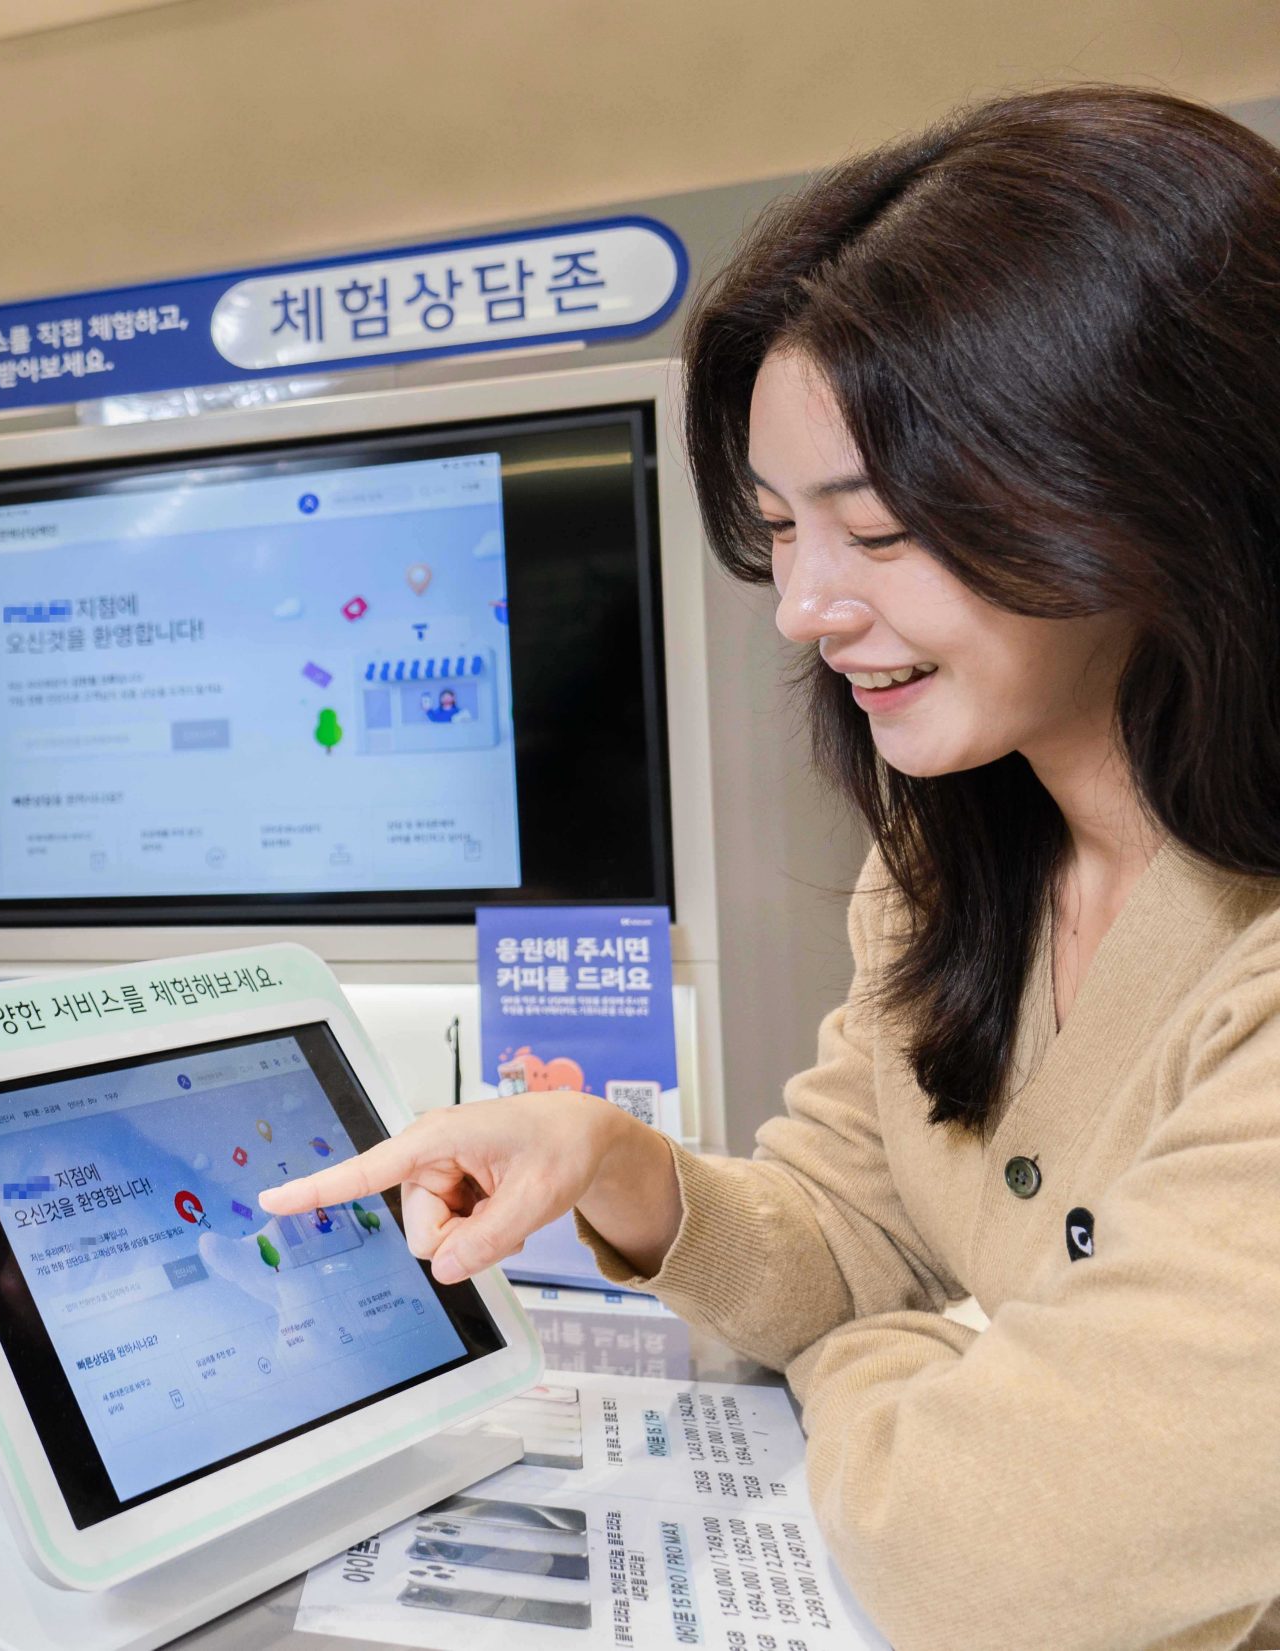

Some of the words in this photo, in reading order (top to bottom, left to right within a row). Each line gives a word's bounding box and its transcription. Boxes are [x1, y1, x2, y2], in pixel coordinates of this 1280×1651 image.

[270, 249, 606, 343] 체험상담존
[36, 318, 84, 349] 직접
[88, 305, 189, 341] 체험하고,
[76, 593, 139, 620] 지점에
[6, 627, 86, 654] 오신것을
[93, 618, 204, 649] 환영합니다!
[496, 937, 569, 963] 응원해
[574, 936, 651, 963] 주시면
[51, 985, 148, 1021] 서비스를
[150, 965, 284, 1008] 체험해보세요.
[496, 966, 570, 992] 커피를
[575, 966, 653, 992] 드려요
[55, 1163, 101, 1188] 지점에
[15, 1197, 76, 1228] 오신것을
[76, 1178, 153, 1212] 환영합니다!
[37, 1264, 51, 1275] 가입
[65, 1254, 91, 1268] 진단으로
[93, 1245, 117, 1259] 고객님의
[131, 1236, 149, 1249] 상담을
[45, 1243, 73, 1258] 우리매장
[76, 1349, 116, 1370] 빠른상담을
[117, 1334, 159, 1358] 원하시나요?
[647, 1436, 667, 1457] 아이폰
[684, 1429, 705, 1461] 1,243,000
[707, 1431, 729, 1464] 1,397,000
[731, 1431, 754, 1466] 1,694,000
[694, 1470, 712, 1494] 128GB
[718, 1472, 738, 1498] 256GB
[743, 1475, 763, 1499] 512GB
[770, 1483, 788, 1496] 1TB
[661, 1520, 681, 1542] MAX
[703, 1516, 729, 1559] 1,749,000
[729, 1518, 755, 1562] 1,892,000
[755, 1523, 783, 1568] 2,220,000
[782, 1523, 811, 1568] 2,497,000
[665, 1543, 686, 1566] PRO
[670, 1574, 690, 1597] PRO
[713, 1567, 741, 1617] 1,540,000
[741, 1570, 770, 1621] 1,694,000
[769, 1575, 799, 1625] 1,991,000
[672, 1598, 692, 1608] 15
[798, 1577, 832, 1629] 2,299,000
[673, 1613, 697, 1644] 아이폰
